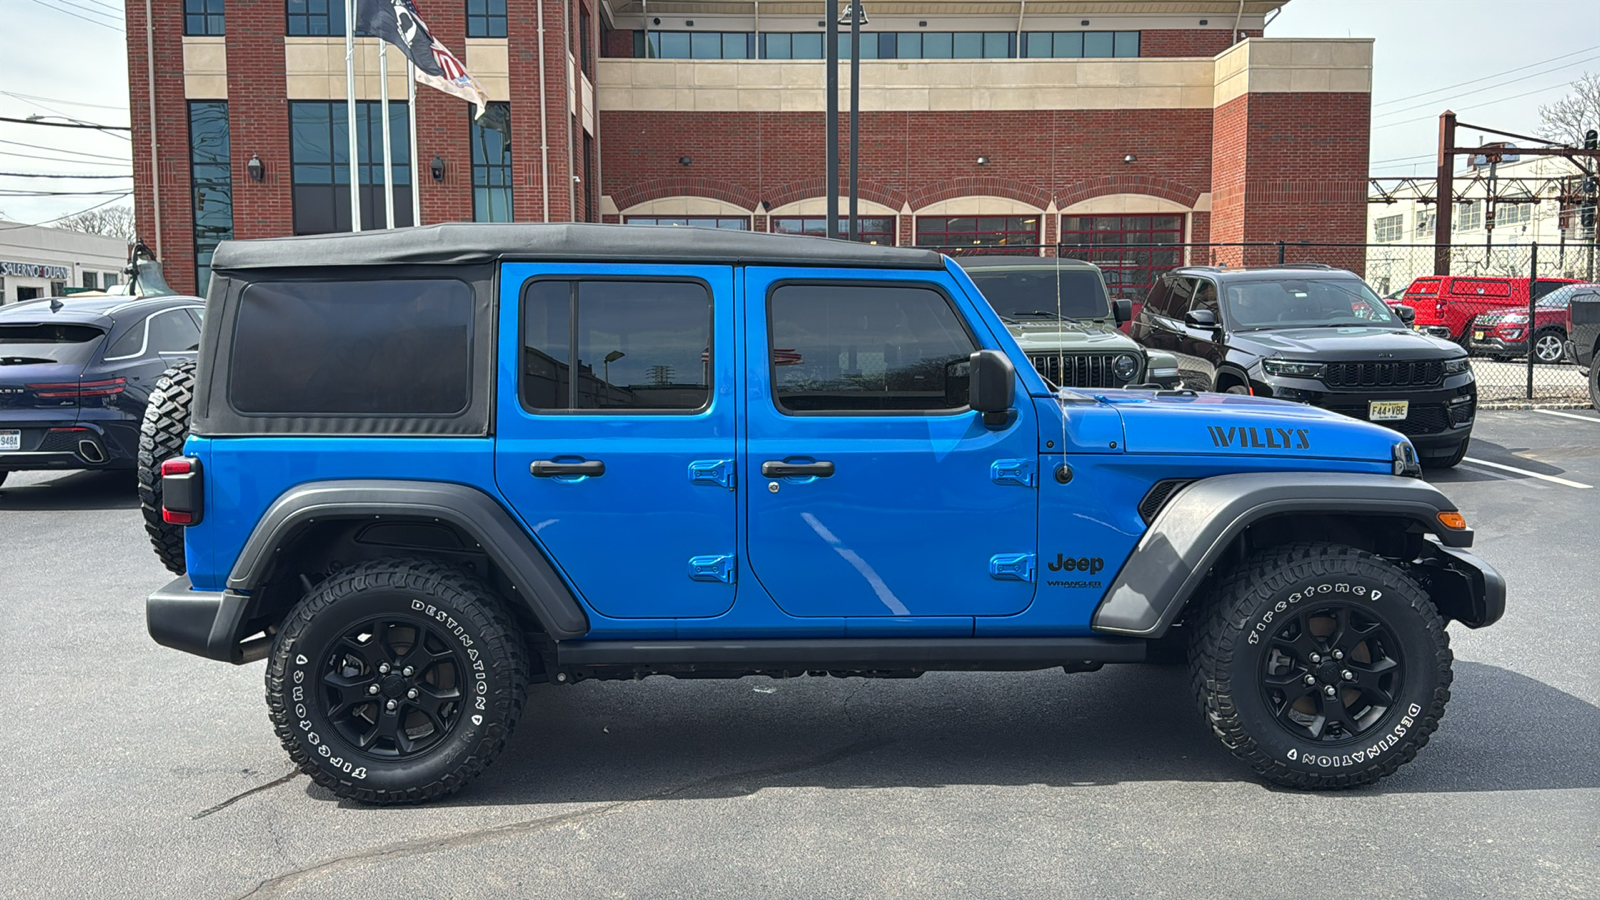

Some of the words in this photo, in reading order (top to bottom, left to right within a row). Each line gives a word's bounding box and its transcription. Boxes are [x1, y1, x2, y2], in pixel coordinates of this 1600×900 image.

[1, 262, 39, 278] SALERNO
[1207, 426, 1310, 449] WILLYS
[1047, 552, 1105, 575] Jeep
[411, 599, 488, 711] DESTINATION
[1302, 703, 1422, 767] DESTINATION
